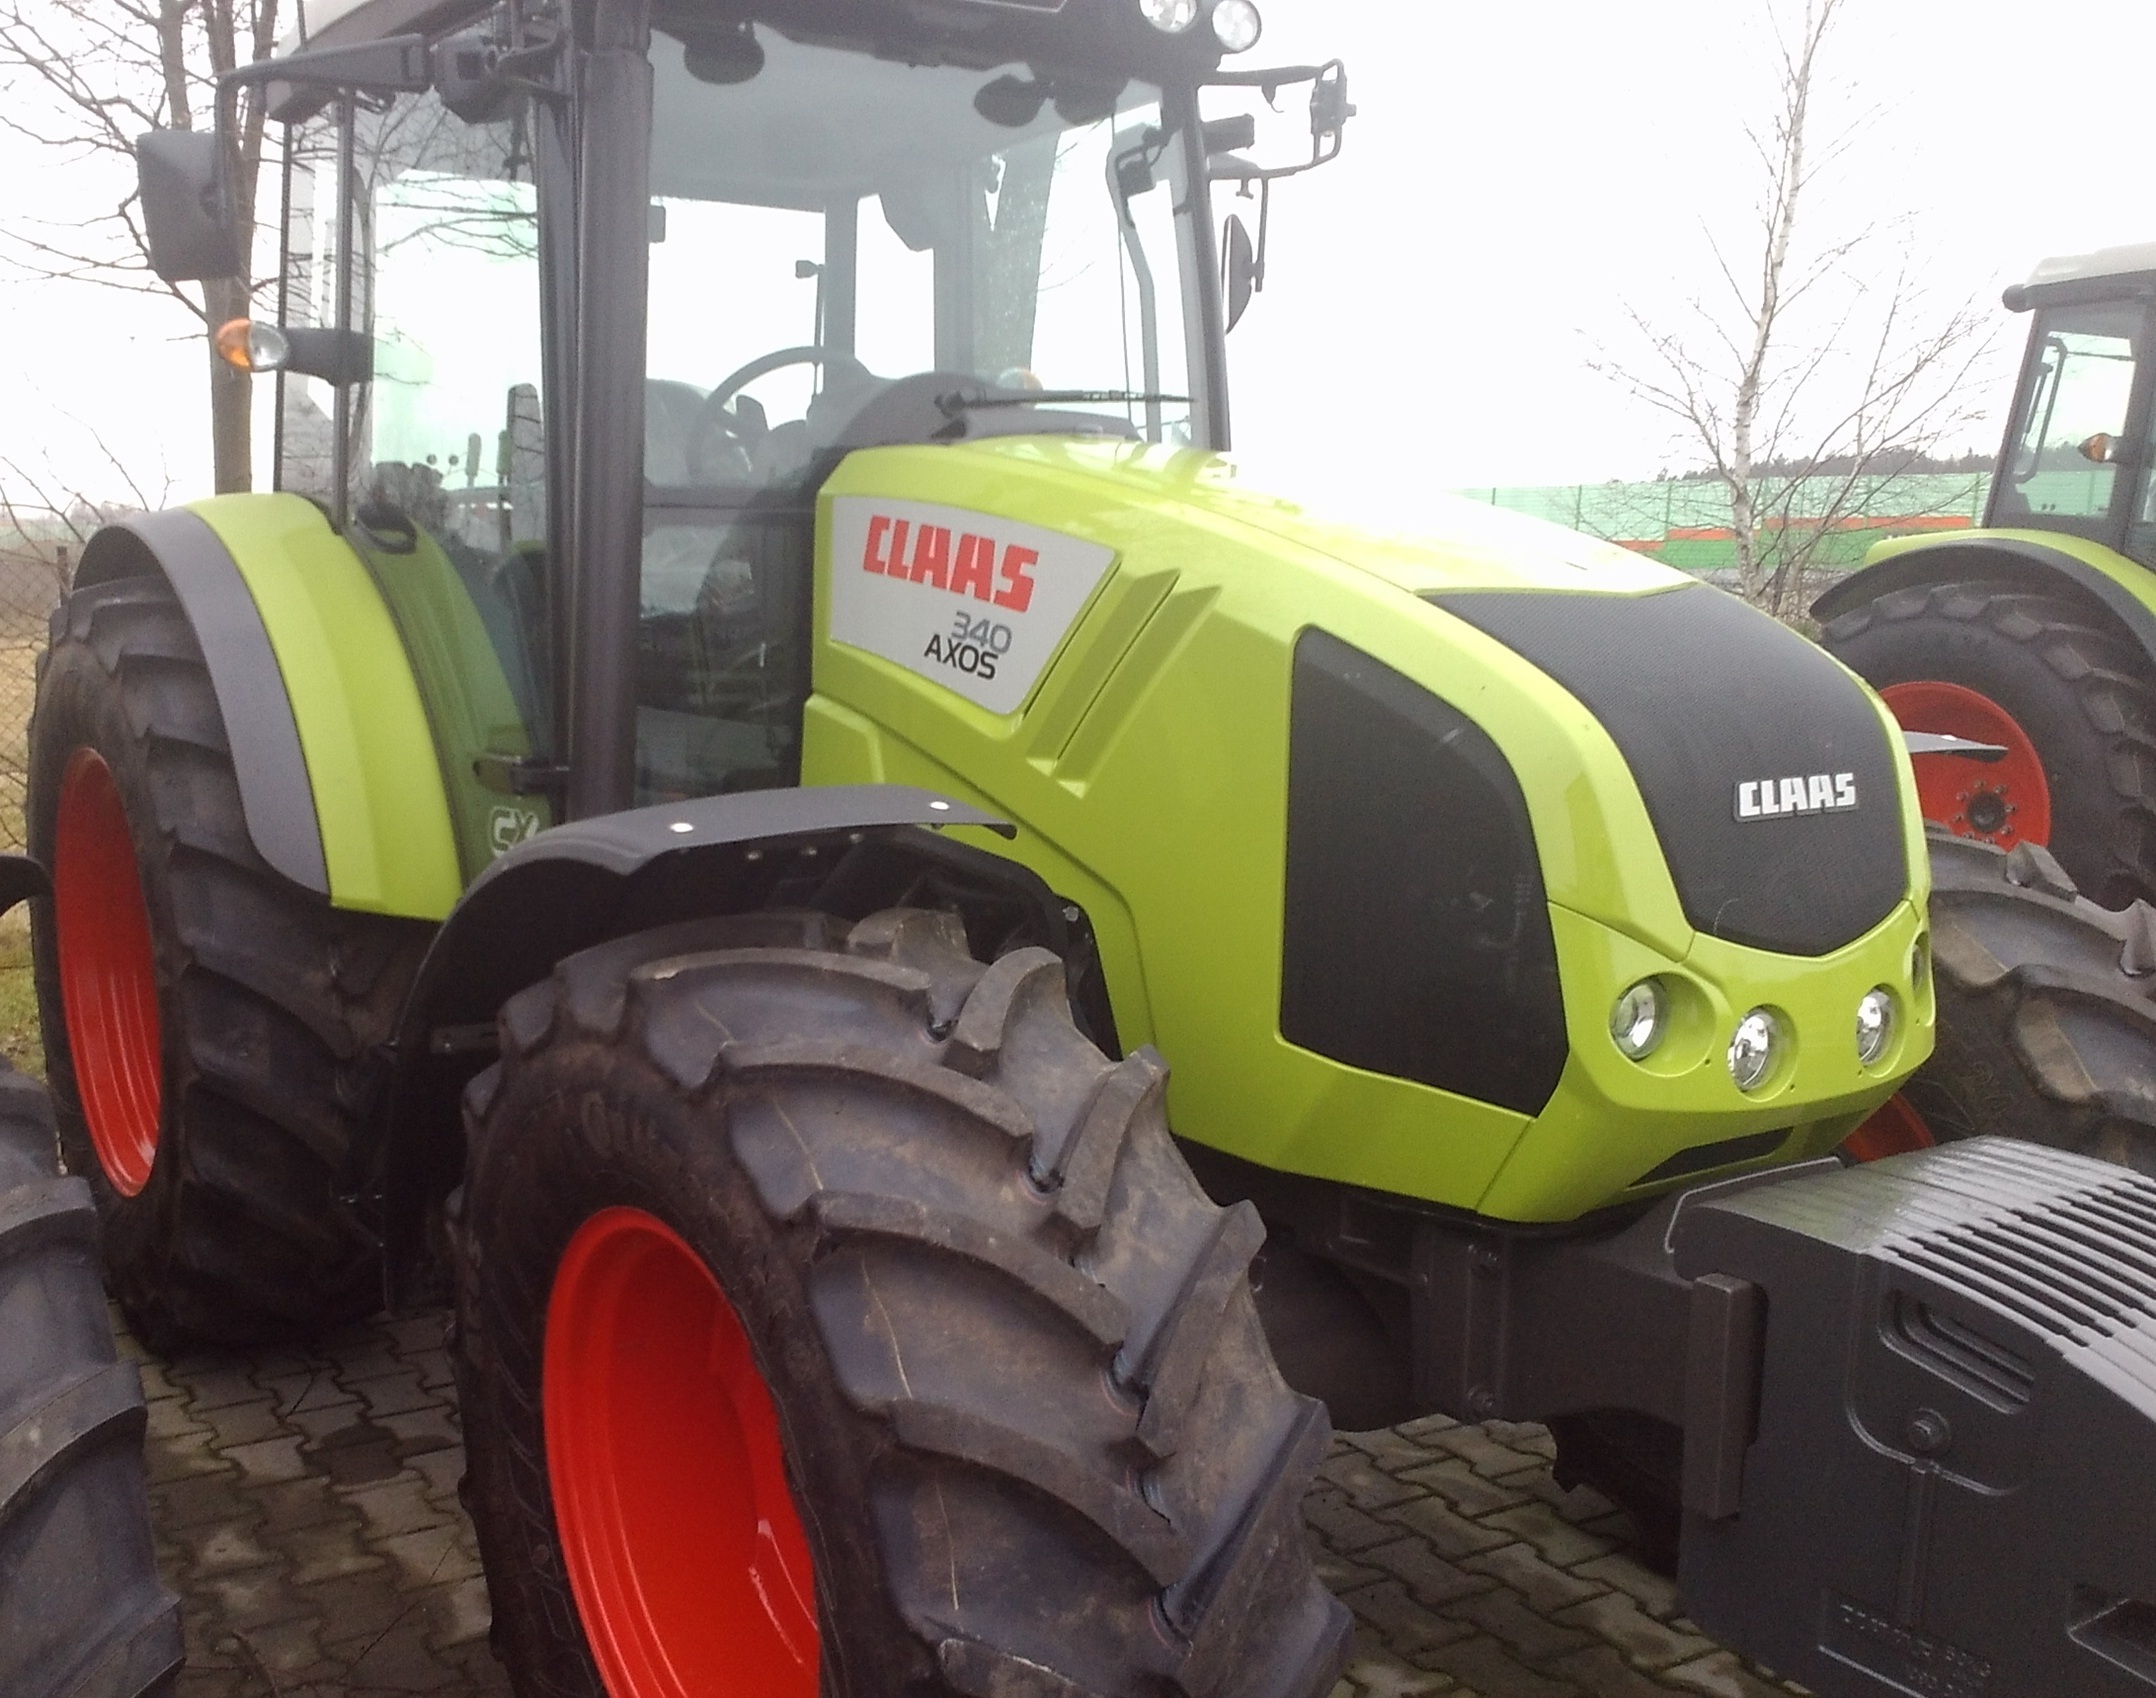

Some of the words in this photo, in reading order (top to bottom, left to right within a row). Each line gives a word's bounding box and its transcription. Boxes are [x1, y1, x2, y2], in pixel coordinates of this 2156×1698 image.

[863, 514, 1039, 613] CLAAS
[951, 610, 1013, 656] 340
[924, 633, 999, 681] AXOS
[1738, 772, 1856, 817] CLAAS
